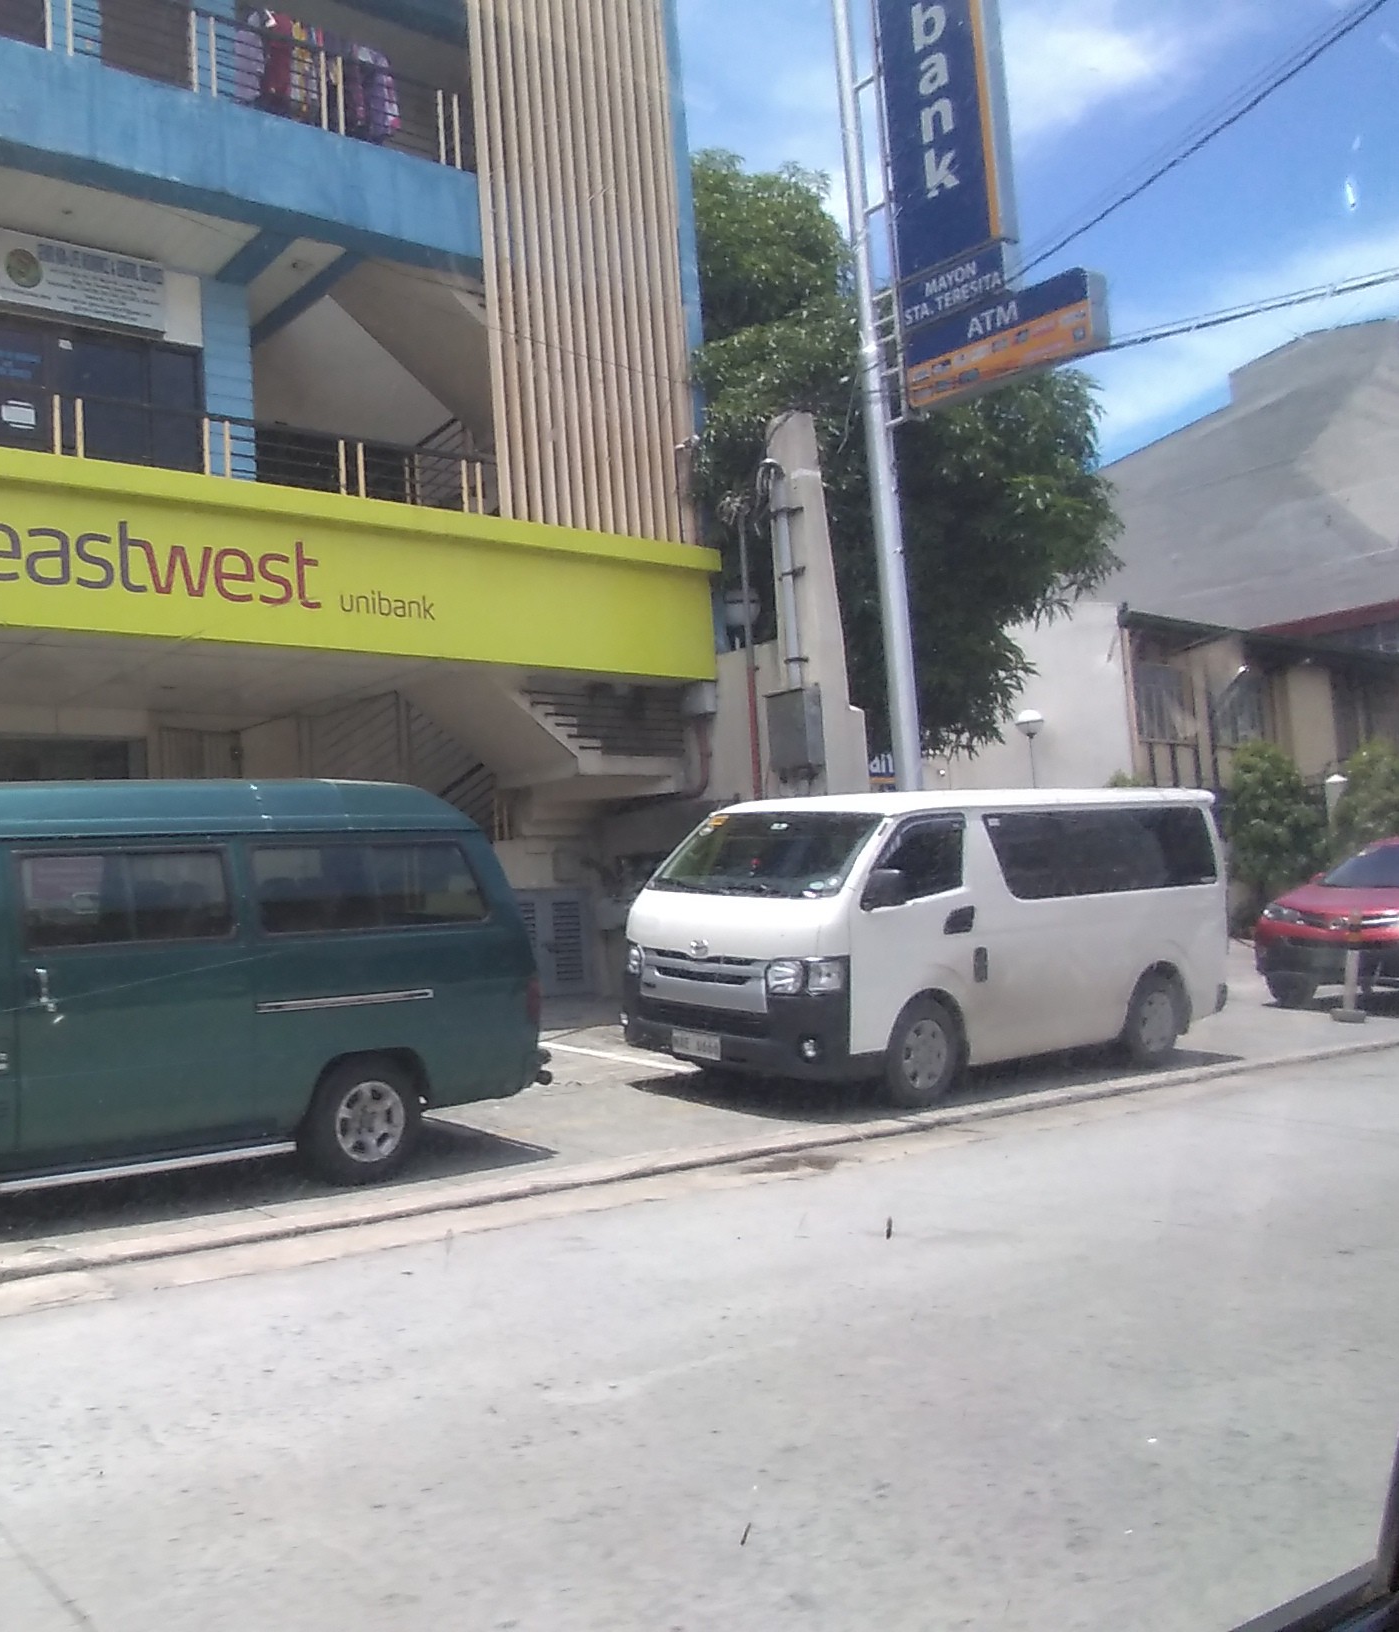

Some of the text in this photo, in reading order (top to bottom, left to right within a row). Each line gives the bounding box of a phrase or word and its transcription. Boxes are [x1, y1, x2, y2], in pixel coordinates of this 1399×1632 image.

[910, 1, 961, 199] bank
[924, 260, 977, 298] MAYON
[904, 271, 1002, 327] STA. TERESITA
[966, 301, 1020, 340] ATM
[339, 589, 436, 622] unibank
